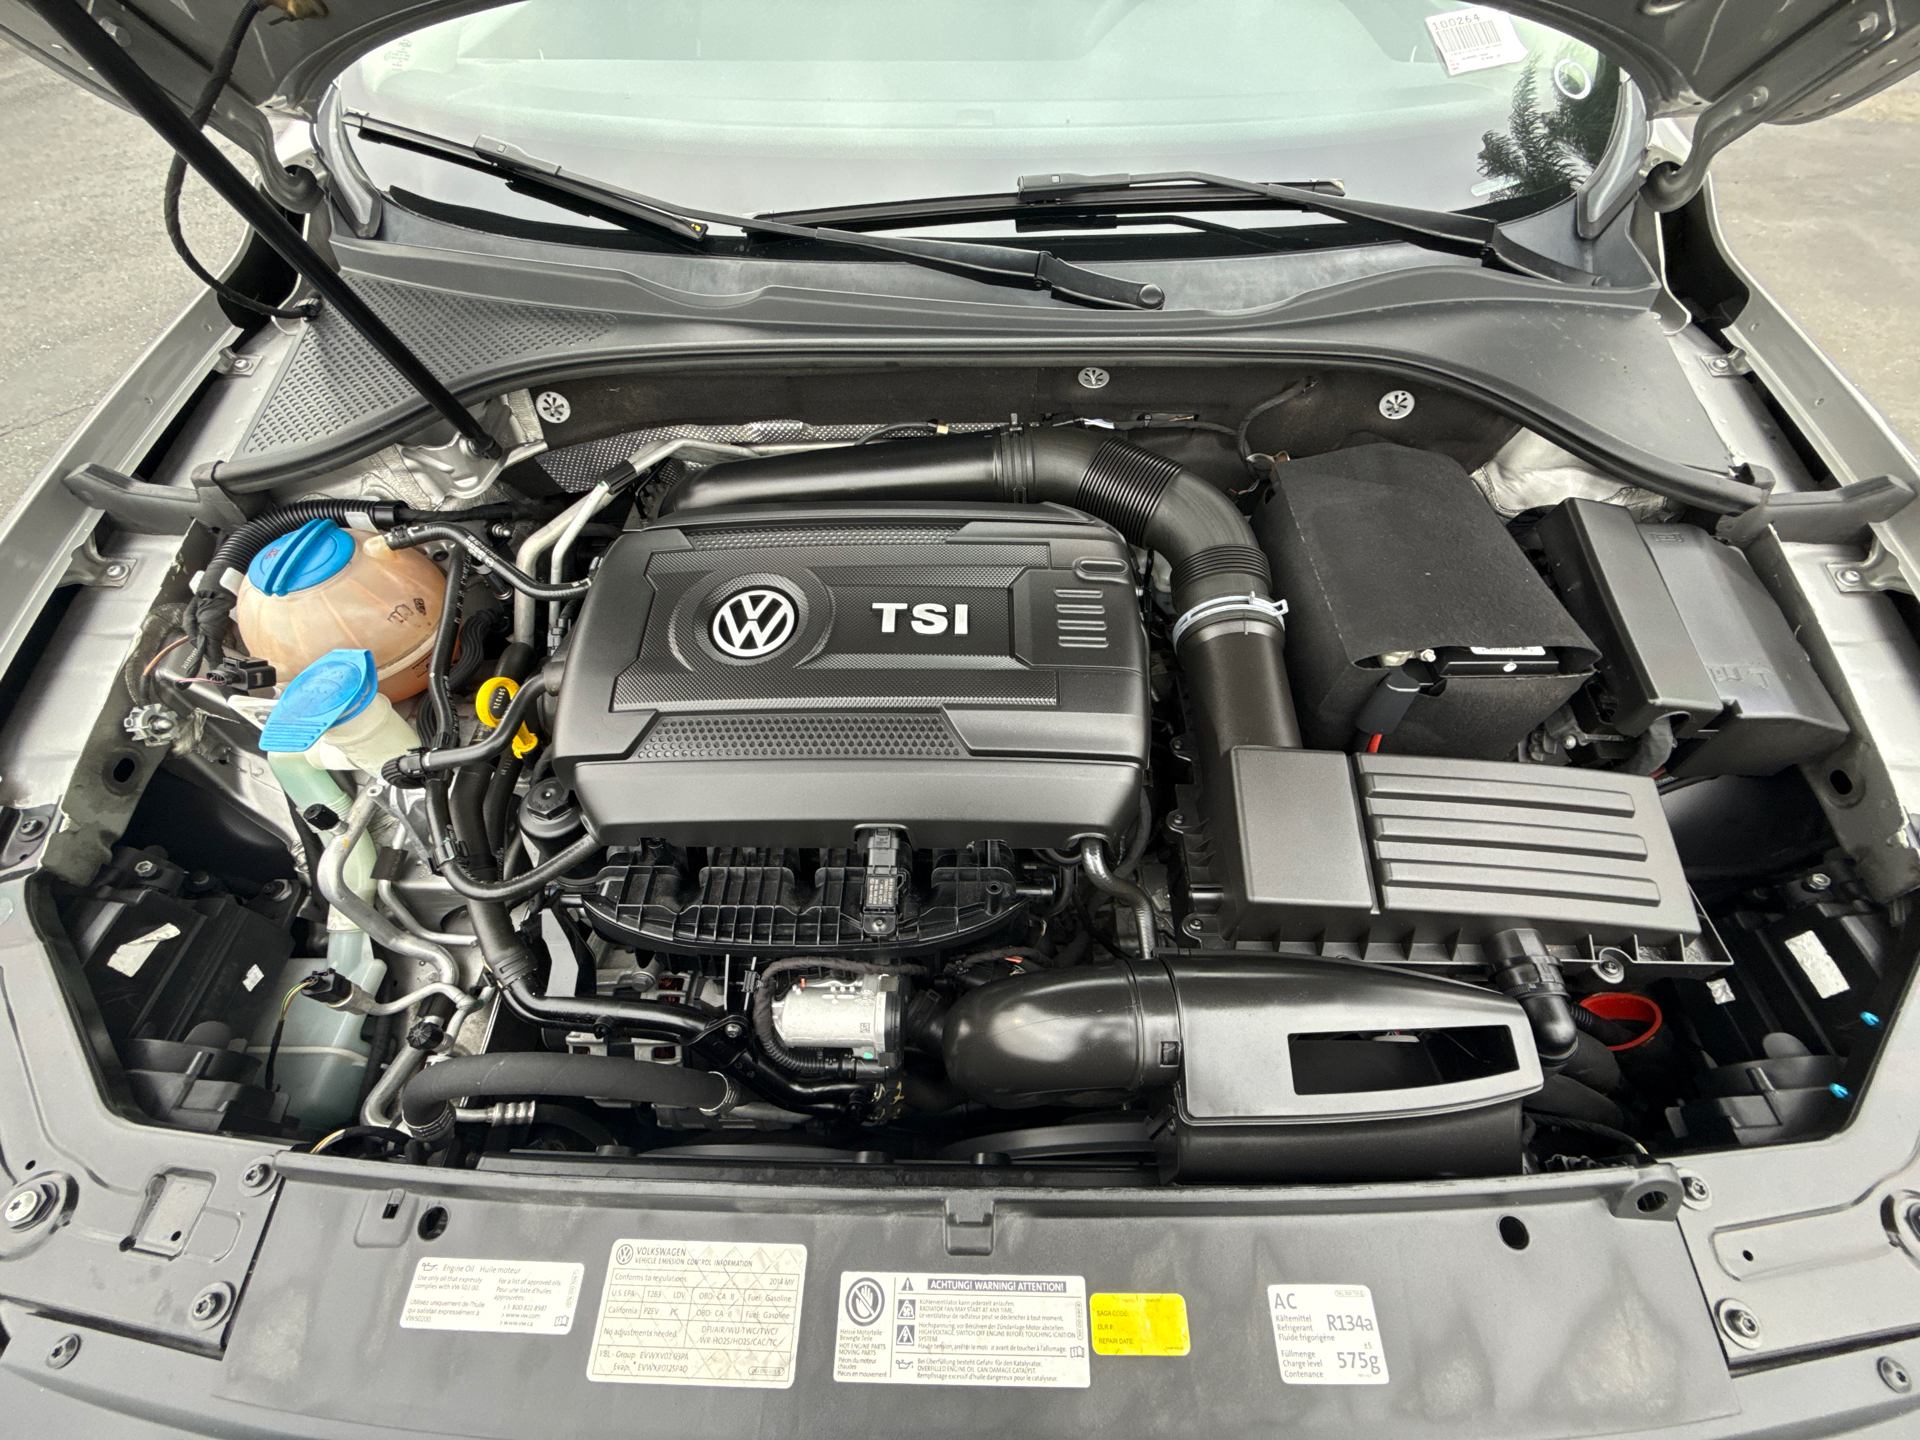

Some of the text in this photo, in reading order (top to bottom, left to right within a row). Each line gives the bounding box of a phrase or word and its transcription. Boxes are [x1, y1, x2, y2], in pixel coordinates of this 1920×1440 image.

[1432, 14, 1480, 30] 100264
[872, 602, 968, 634] TSI
[637, 1247, 686, 1256] VOLKSWAGEN
[443, 1264, 464, 1273] Engine
[615, 1273, 644, 1281] Conforms
[931, 1280, 1063, 1291] ACHTUNG! WARNING! ATTENTION!
[765, 1294, 792, 1302] Gasoline
[1275, 1293, 1297, 1309] AC
[763, 1311, 790, 1319] Gasoline
[1327, 1314, 1373, 1331] R134a
[1277, 1324, 1313, 1333] Refrigerant
[1281, 1350, 1315, 1359] Füllmenge
[1283, 1360, 1306, 1369] Charge
[1337, 1352, 1380, 1374] 575g
[1285, 1370, 1323, 1378] Contenance
